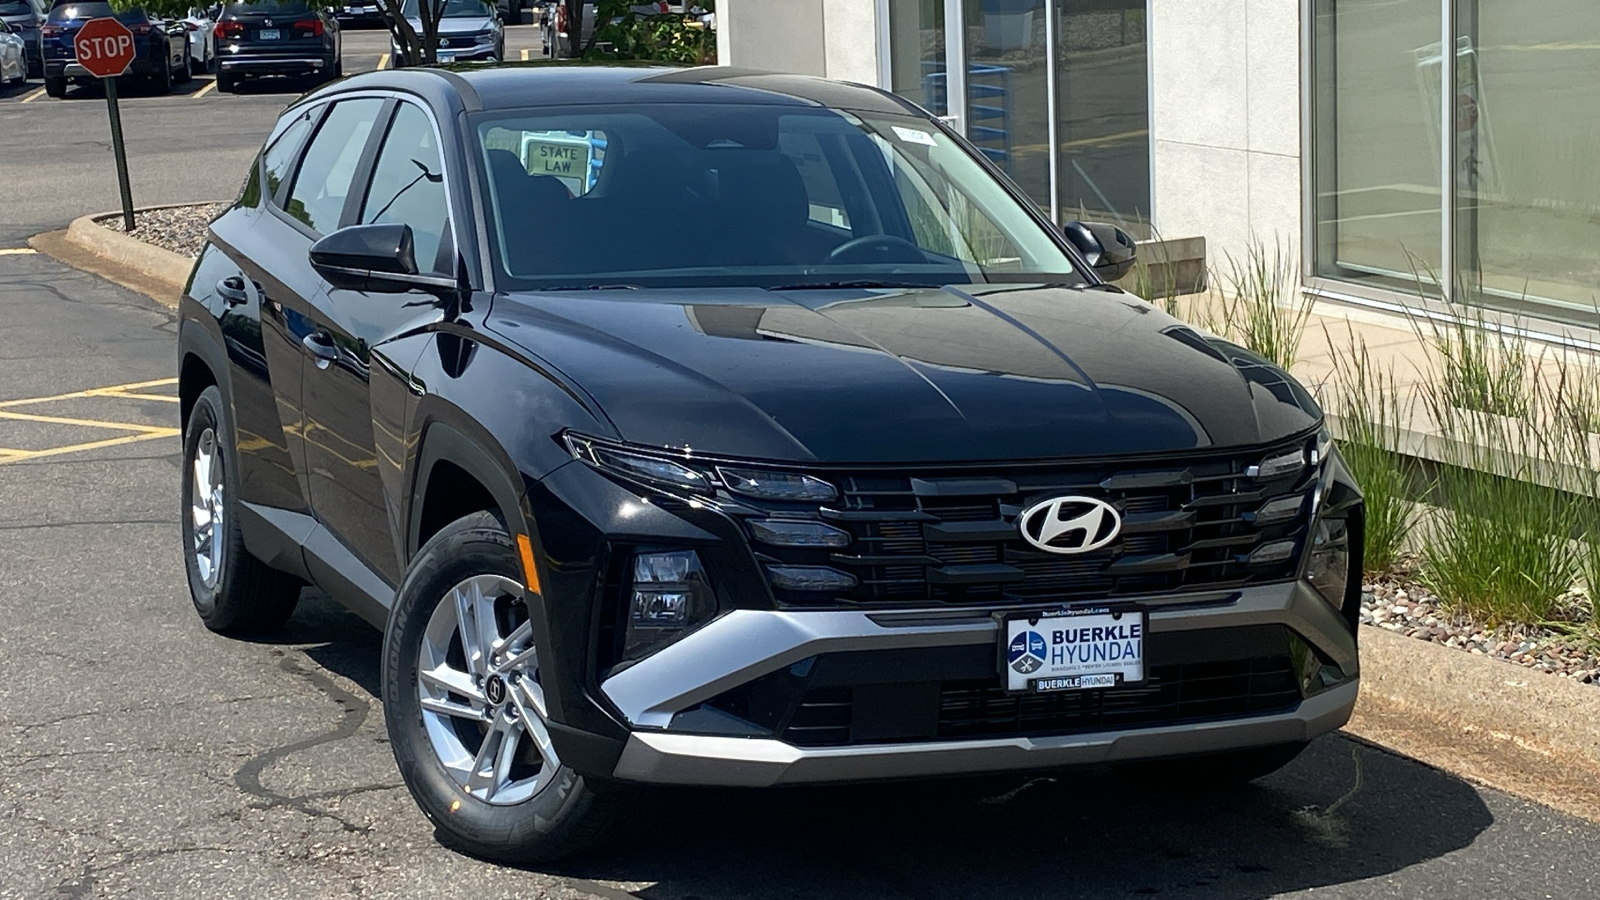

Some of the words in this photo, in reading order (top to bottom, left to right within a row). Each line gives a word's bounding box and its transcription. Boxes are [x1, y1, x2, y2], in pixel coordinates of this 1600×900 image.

[79, 35, 131, 60] STOP
[540, 145, 578, 160] STATE
[545, 160, 571, 173] LAW
[1052, 624, 1141, 645] BUERKLE
[1051, 640, 1141, 666] HYUNDAI
[1038, 677, 1080, 690] BUERKLE
[1081, 674, 1113, 687] HYUNDAI
